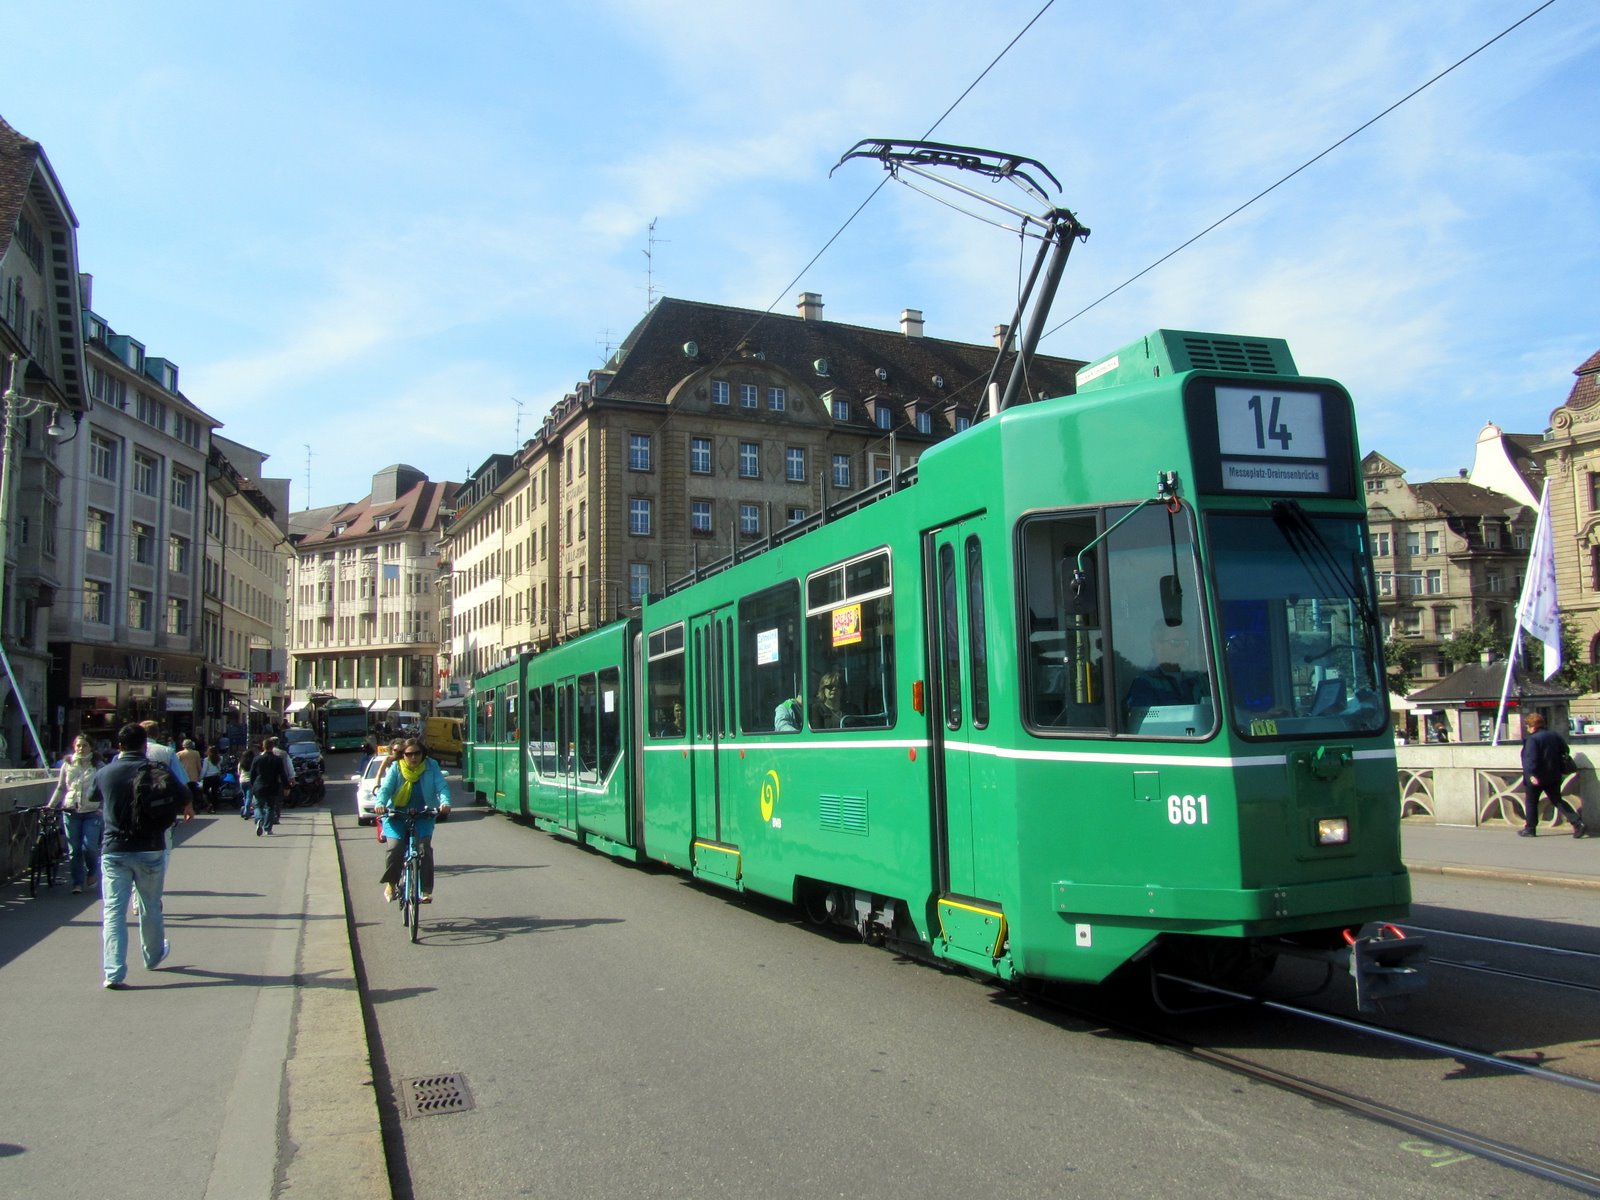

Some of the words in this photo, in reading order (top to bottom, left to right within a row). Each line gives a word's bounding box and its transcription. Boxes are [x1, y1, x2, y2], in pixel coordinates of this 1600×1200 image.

[1248, 395, 1293, 451] 14
[1229, 466, 1320, 480] Messeplatz-Dreirosenbrücke
[834, 611, 853, 631] GREASE
[1167, 794, 1209, 825] 661
